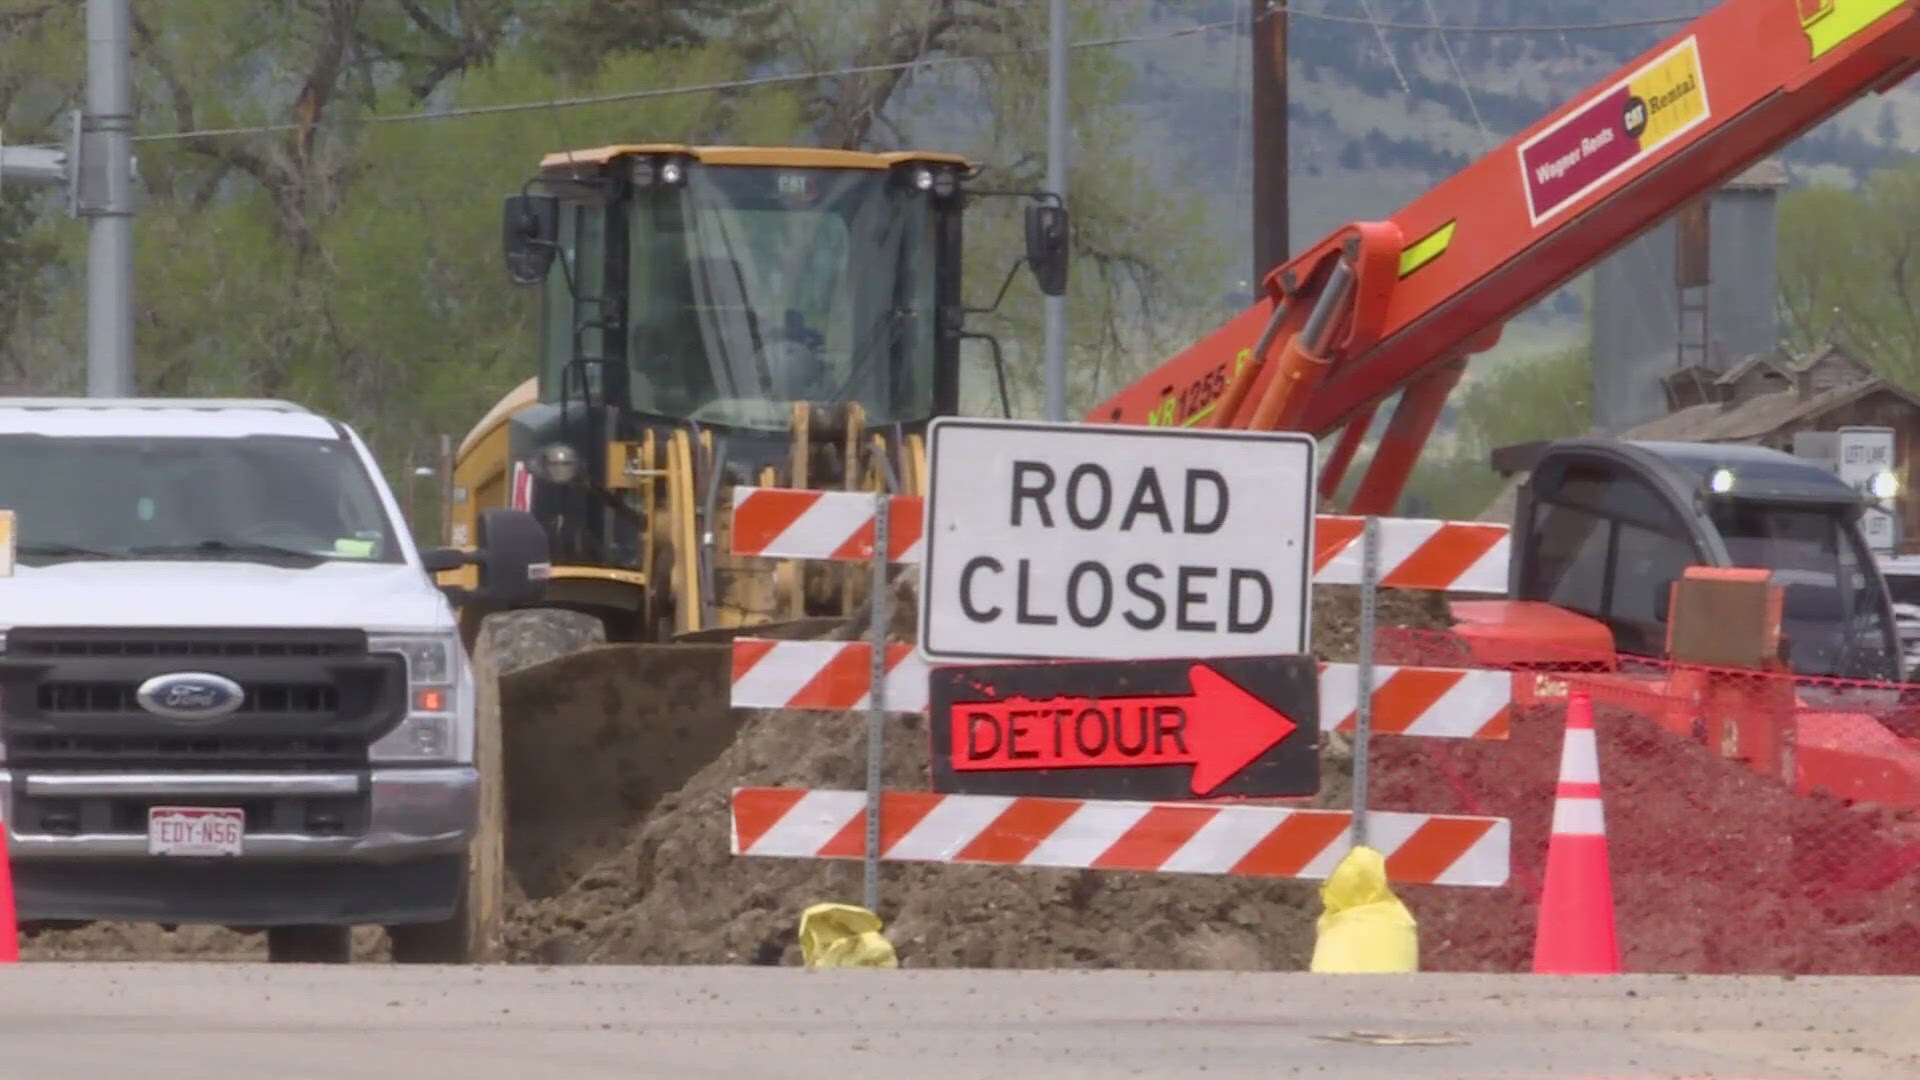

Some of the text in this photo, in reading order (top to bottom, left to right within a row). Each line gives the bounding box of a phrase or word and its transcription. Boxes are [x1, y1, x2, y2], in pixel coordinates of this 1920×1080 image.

[1624, 74, 1696, 130] CAT Rental
[1535, 127, 1614, 184] Wagner Rents
[1009, 460, 1230, 535] ROAD
[959, 556, 1273, 634] CLOSED
[166, 684, 217, 706] Ford
[967, 706, 1189, 762] DETOUR
[160, 821, 238, 844] EDY-N56
